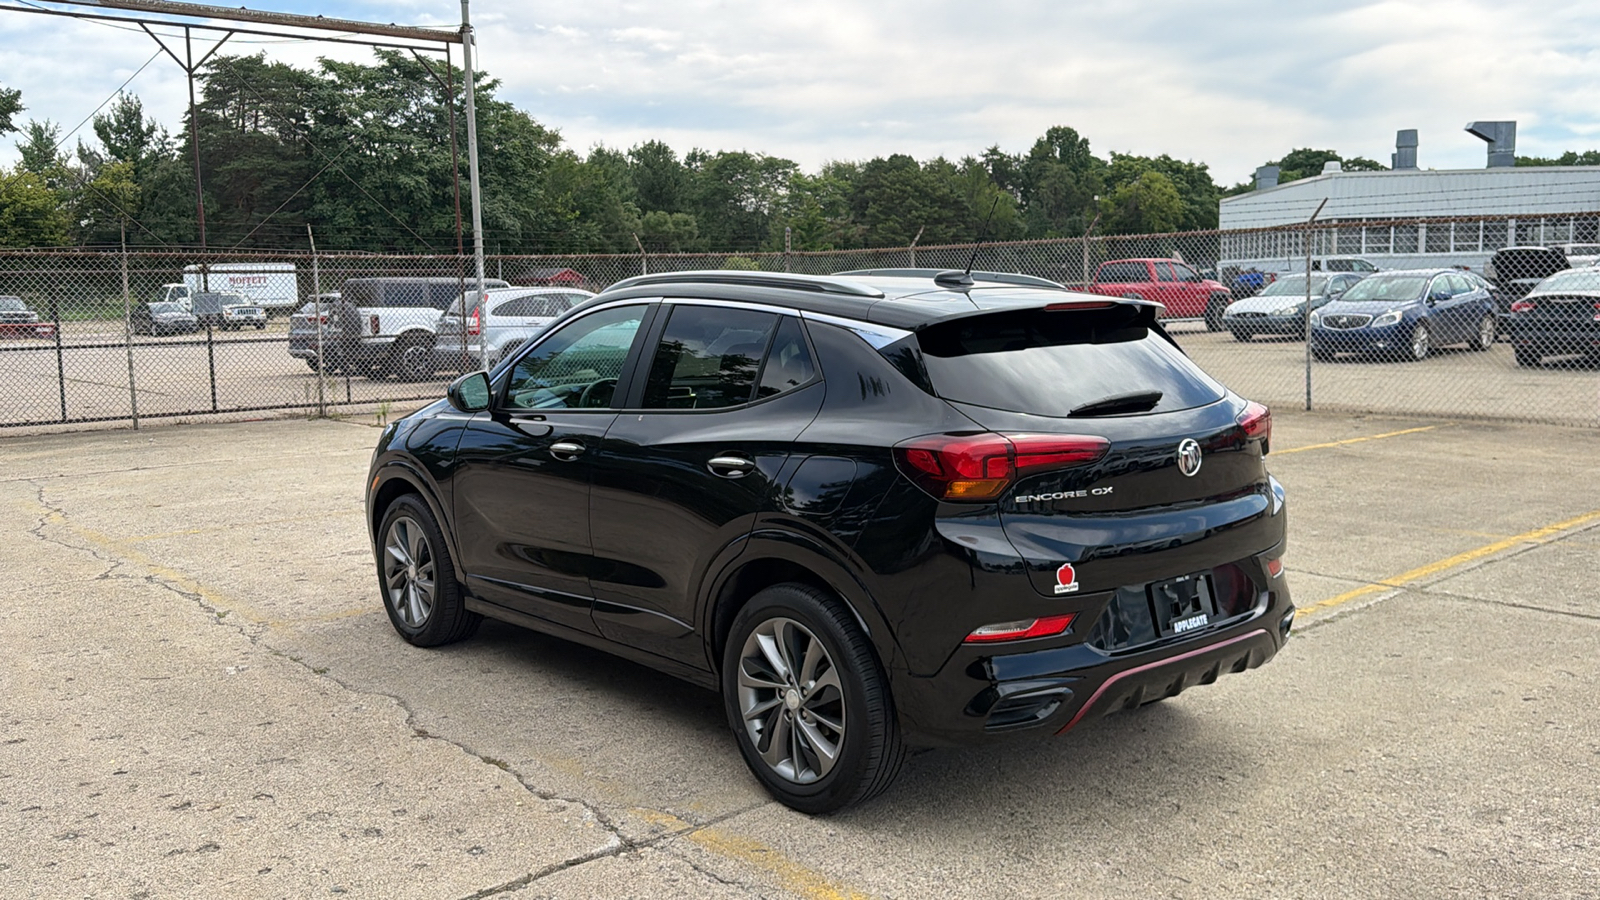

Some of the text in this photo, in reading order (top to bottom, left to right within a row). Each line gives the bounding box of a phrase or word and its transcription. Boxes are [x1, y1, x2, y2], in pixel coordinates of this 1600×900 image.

[228, 276, 267, 284] MOFFETT
[1015, 486, 1113, 503] ENCORE GX
[1174, 614, 1208, 633] APPLEGATE
